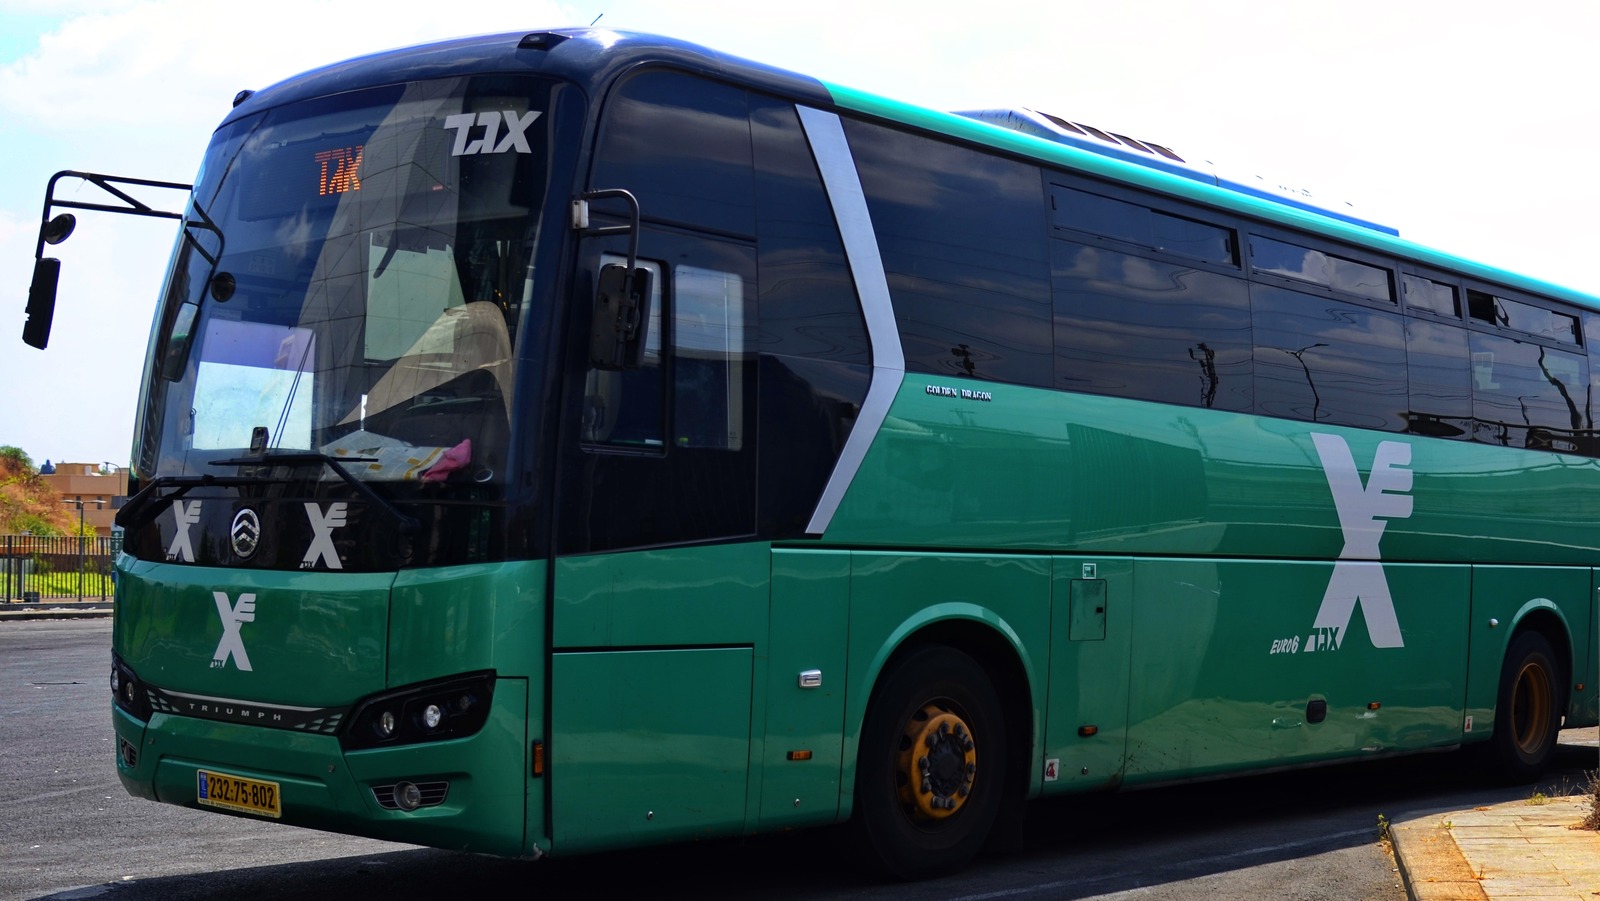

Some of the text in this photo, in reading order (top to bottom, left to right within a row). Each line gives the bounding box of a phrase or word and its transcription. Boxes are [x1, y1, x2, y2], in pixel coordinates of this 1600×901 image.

[443, 110, 543, 156] אגד
[315, 145, 363, 196] אגד
[926, 385, 992, 402] GOLDEN DRAGON
[1270, 635, 1300, 655] EURO6
[189, 703, 281, 721] TRIUMPH
